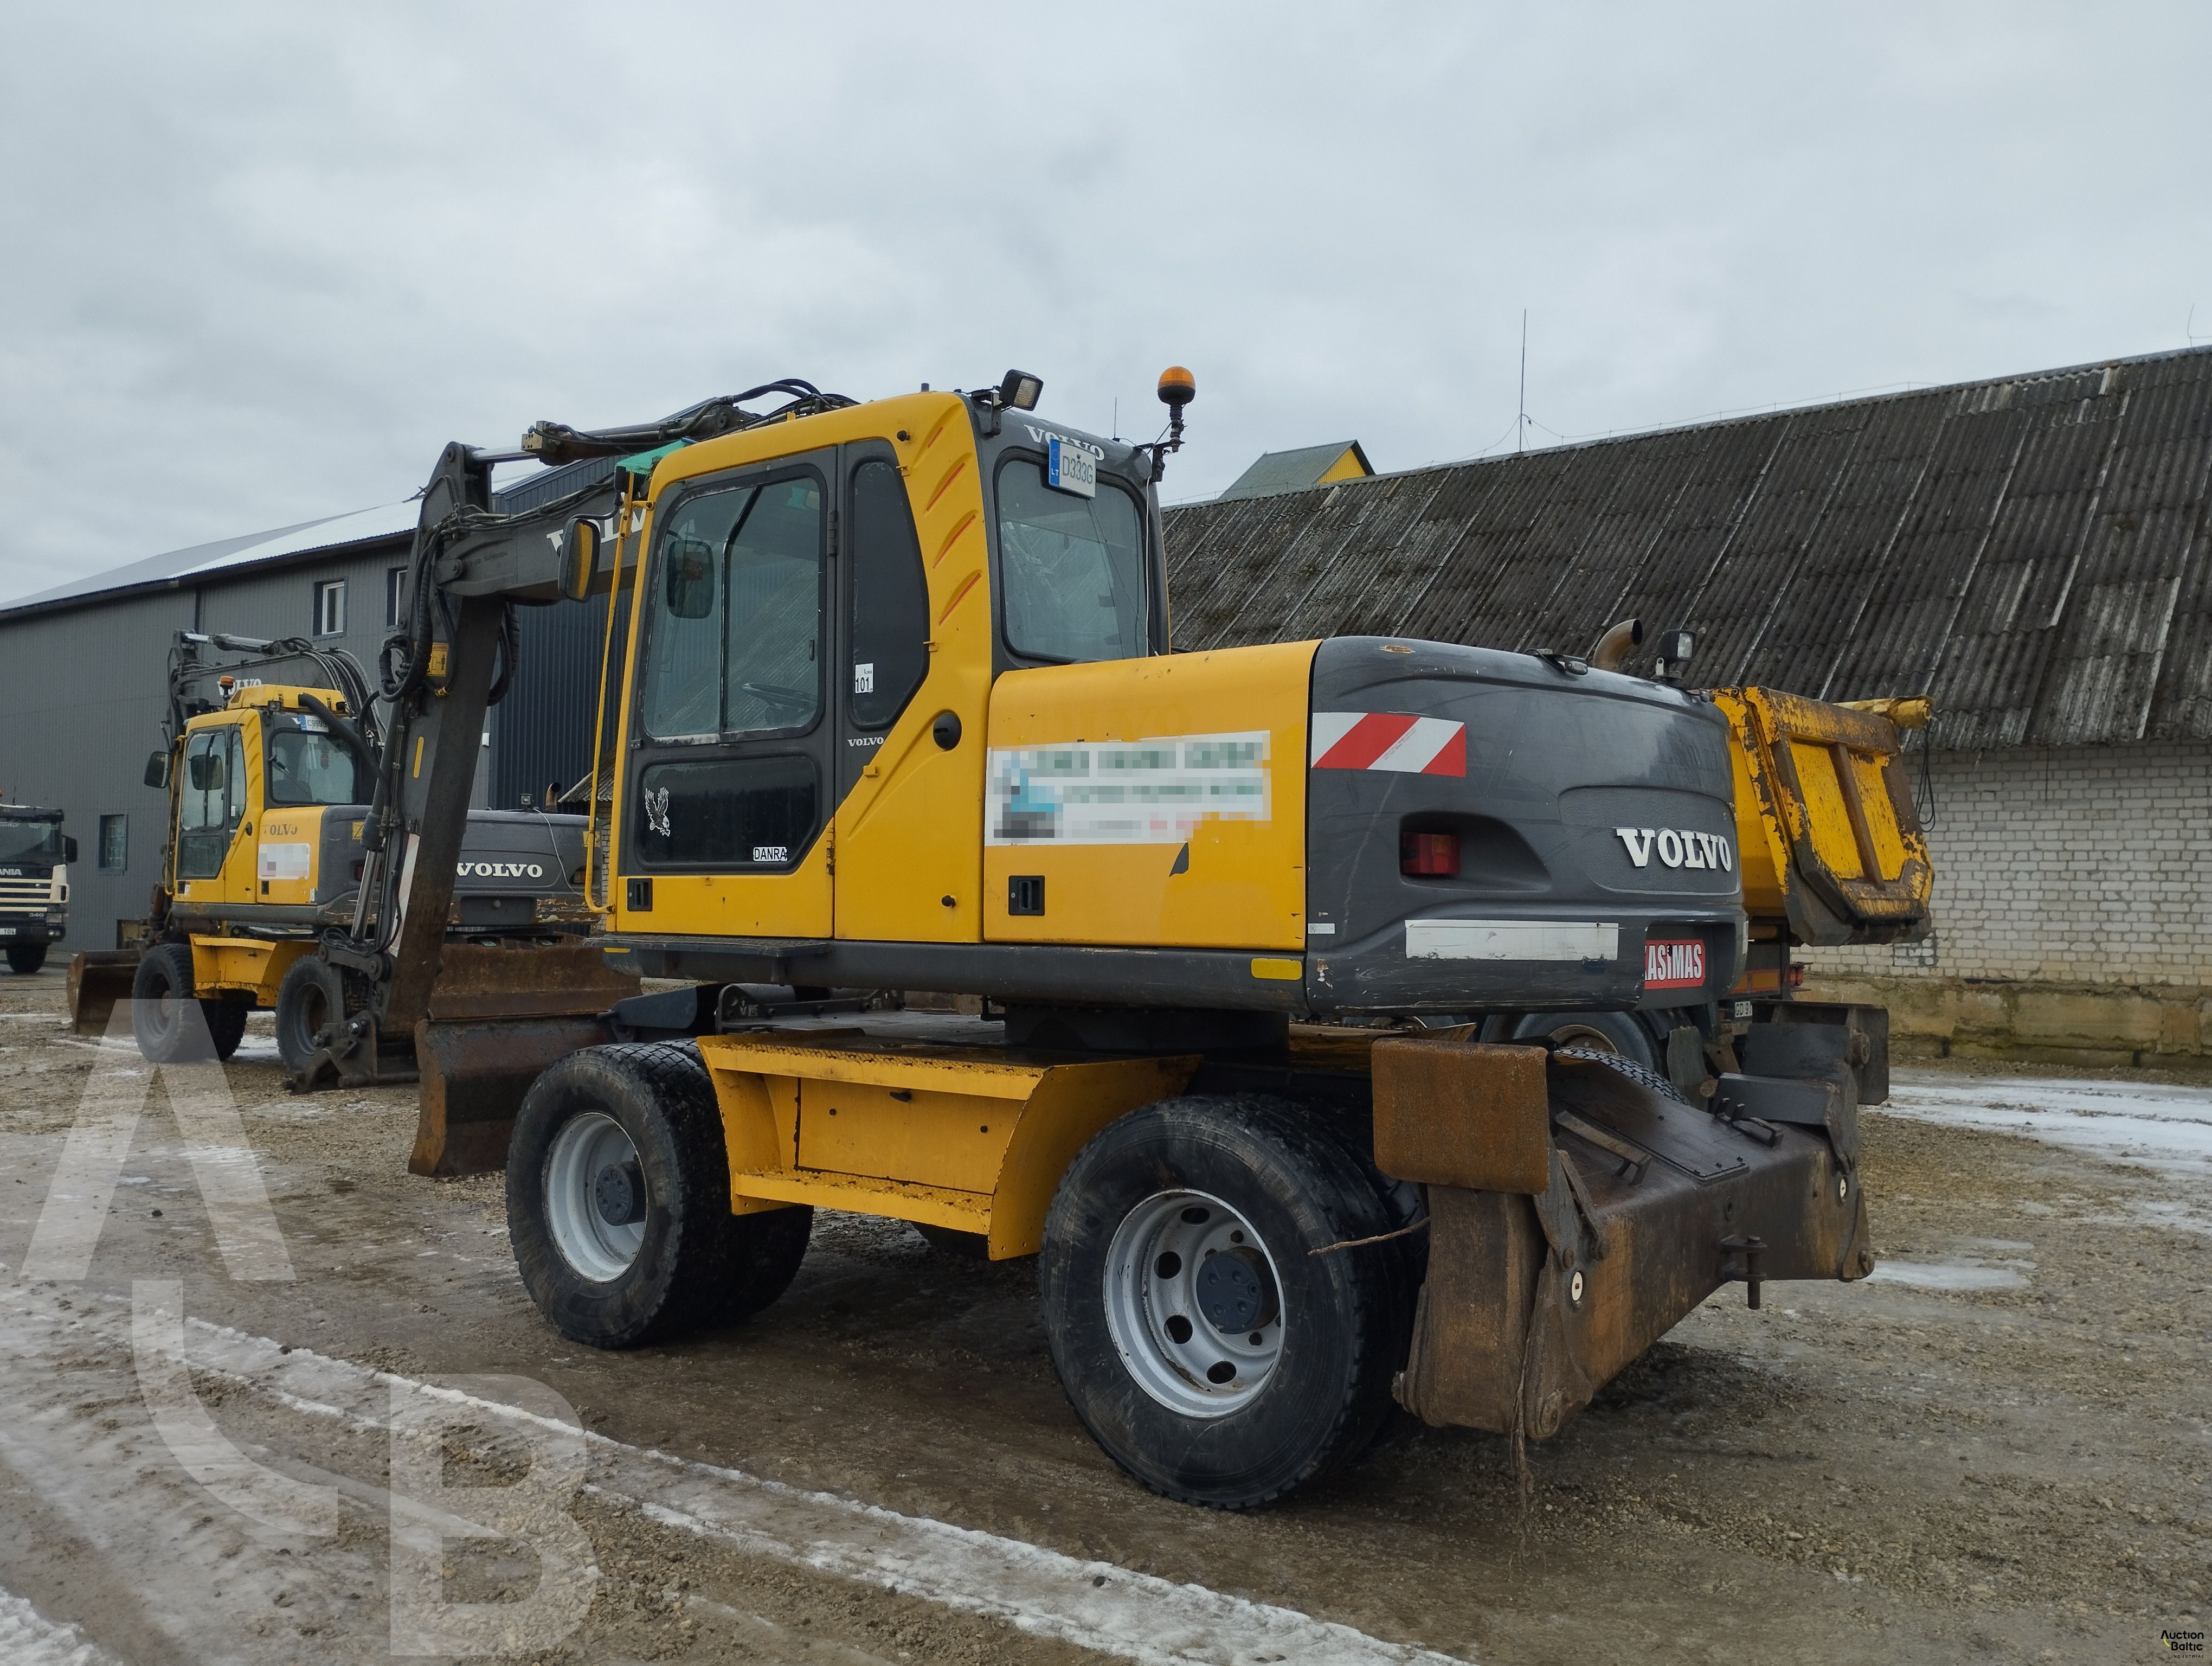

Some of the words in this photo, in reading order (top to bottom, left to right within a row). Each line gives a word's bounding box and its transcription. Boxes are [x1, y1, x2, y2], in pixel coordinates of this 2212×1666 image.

[1051, 468, 1059, 477] LT
[1063, 455, 1093, 484] D333G
[856, 677, 869, 692] 101
[847, 737, 884, 747] VOLVO
[754, 848, 786, 860] DANRA
[1616, 829, 1732, 872] VOLVO
[456, 863, 543, 877] VOLVO
